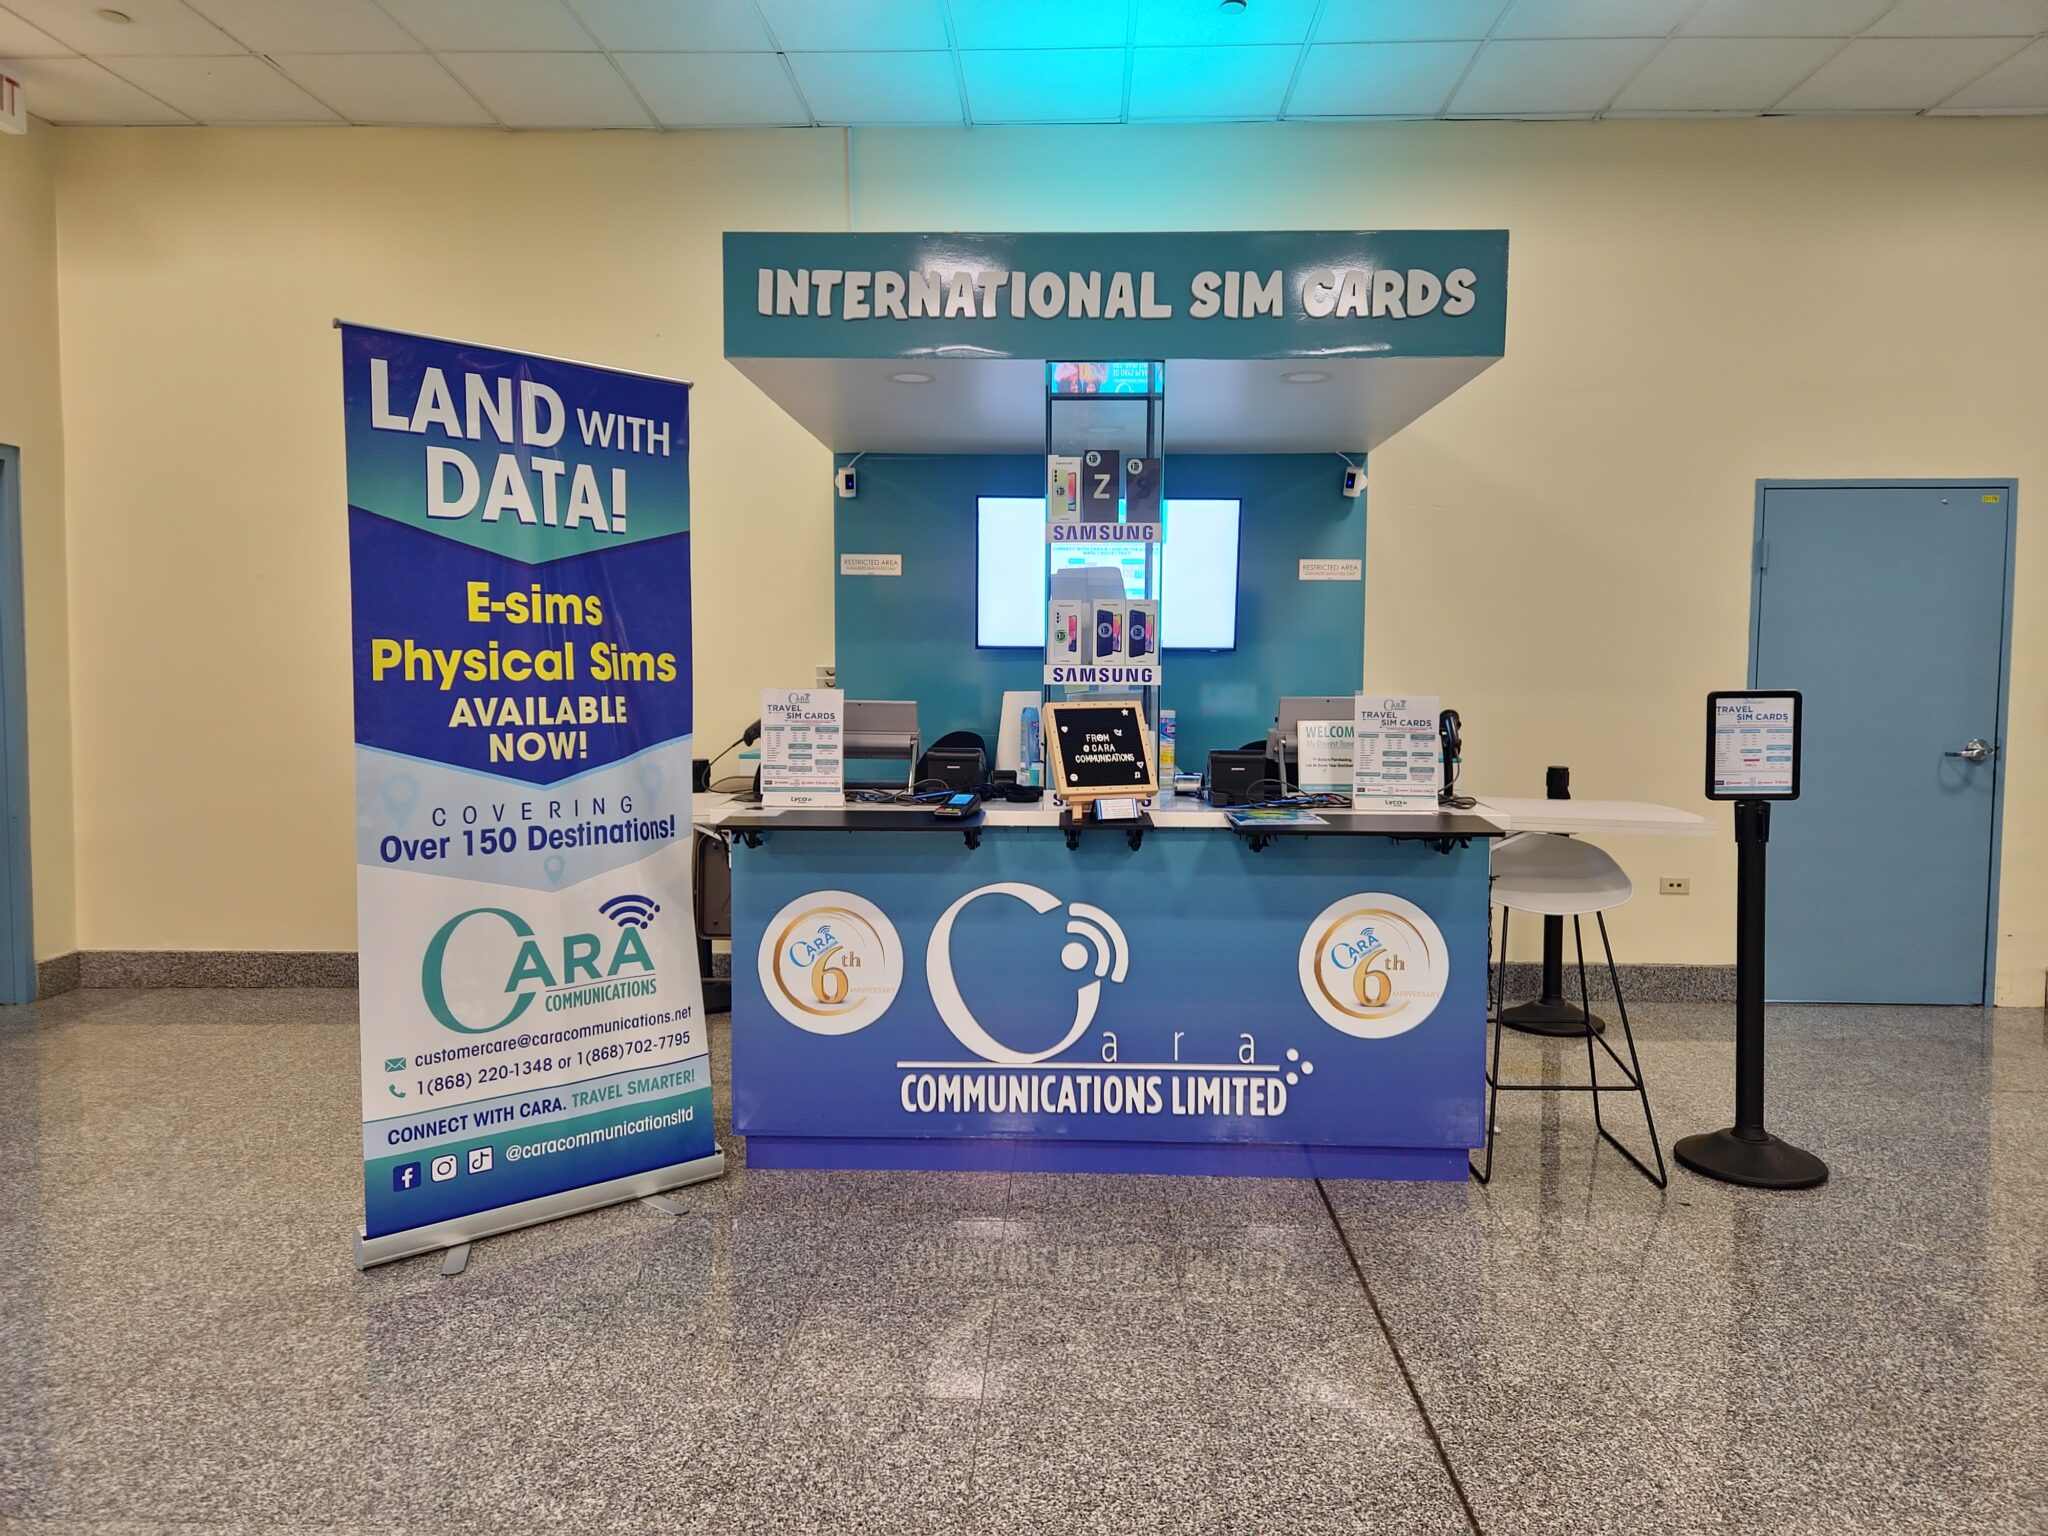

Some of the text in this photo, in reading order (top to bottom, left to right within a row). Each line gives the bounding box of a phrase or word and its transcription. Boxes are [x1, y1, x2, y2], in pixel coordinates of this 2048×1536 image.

[757, 267, 1478, 321] INTERNATIONAL SIM CARDS
[370, 358, 670, 456] LAND WITH
[425, 446, 627, 534] DATA!
[1093, 473, 1111, 499] Z
[1053, 525, 1154, 541] SAMSUNG
[466, 581, 603, 625] E-sims
[371, 639, 677, 691] Physical Sims
[1053, 667, 1153, 683] SAMSUNG
[448, 696, 628, 728] AVAILABLE
[767, 704, 802, 712] TRAVEL
[804, 712, 836, 720] CARDS
[1361, 711, 1398, 719] TRAVEL
[1381, 719, 1397, 727] SIM
[489, 731, 588, 763] NOW!
[1086, 734, 1110, 742] FROM
[1091, 743, 1116, 752] CARA
[1305, 726, 1354, 738] WELCOM
[1340, 740, 1354, 748] Trave
[1075, 753, 1135, 763] COMMUNICATIONS
[432, 795, 633, 827] COVERING
[380, 814, 676, 863] Over 150 Destinations!
[789, 932, 836, 968] CARA
[1331, 935, 1379, 969] CARA
[421, 907, 656, 1035] CARA
[544, 978, 658, 1012] COMMUNICATIONS
[1392, 990, 1440, 998] ANNIVERSARY
[414, 1006, 692, 1068] customercare@caracommunications.net
[416, 1031, 691, 1098] 1(868) 220-1348 or 1(868)702-7795
[387, 1068, 696, 1145] CONNECT WITH CARA. TRAVEL SMARTER!
[900, 1074, 1287, 1117] COMMUNICATIONS LIMITED
[505, 1105, 694, 1162] @caracommunicationsltd
